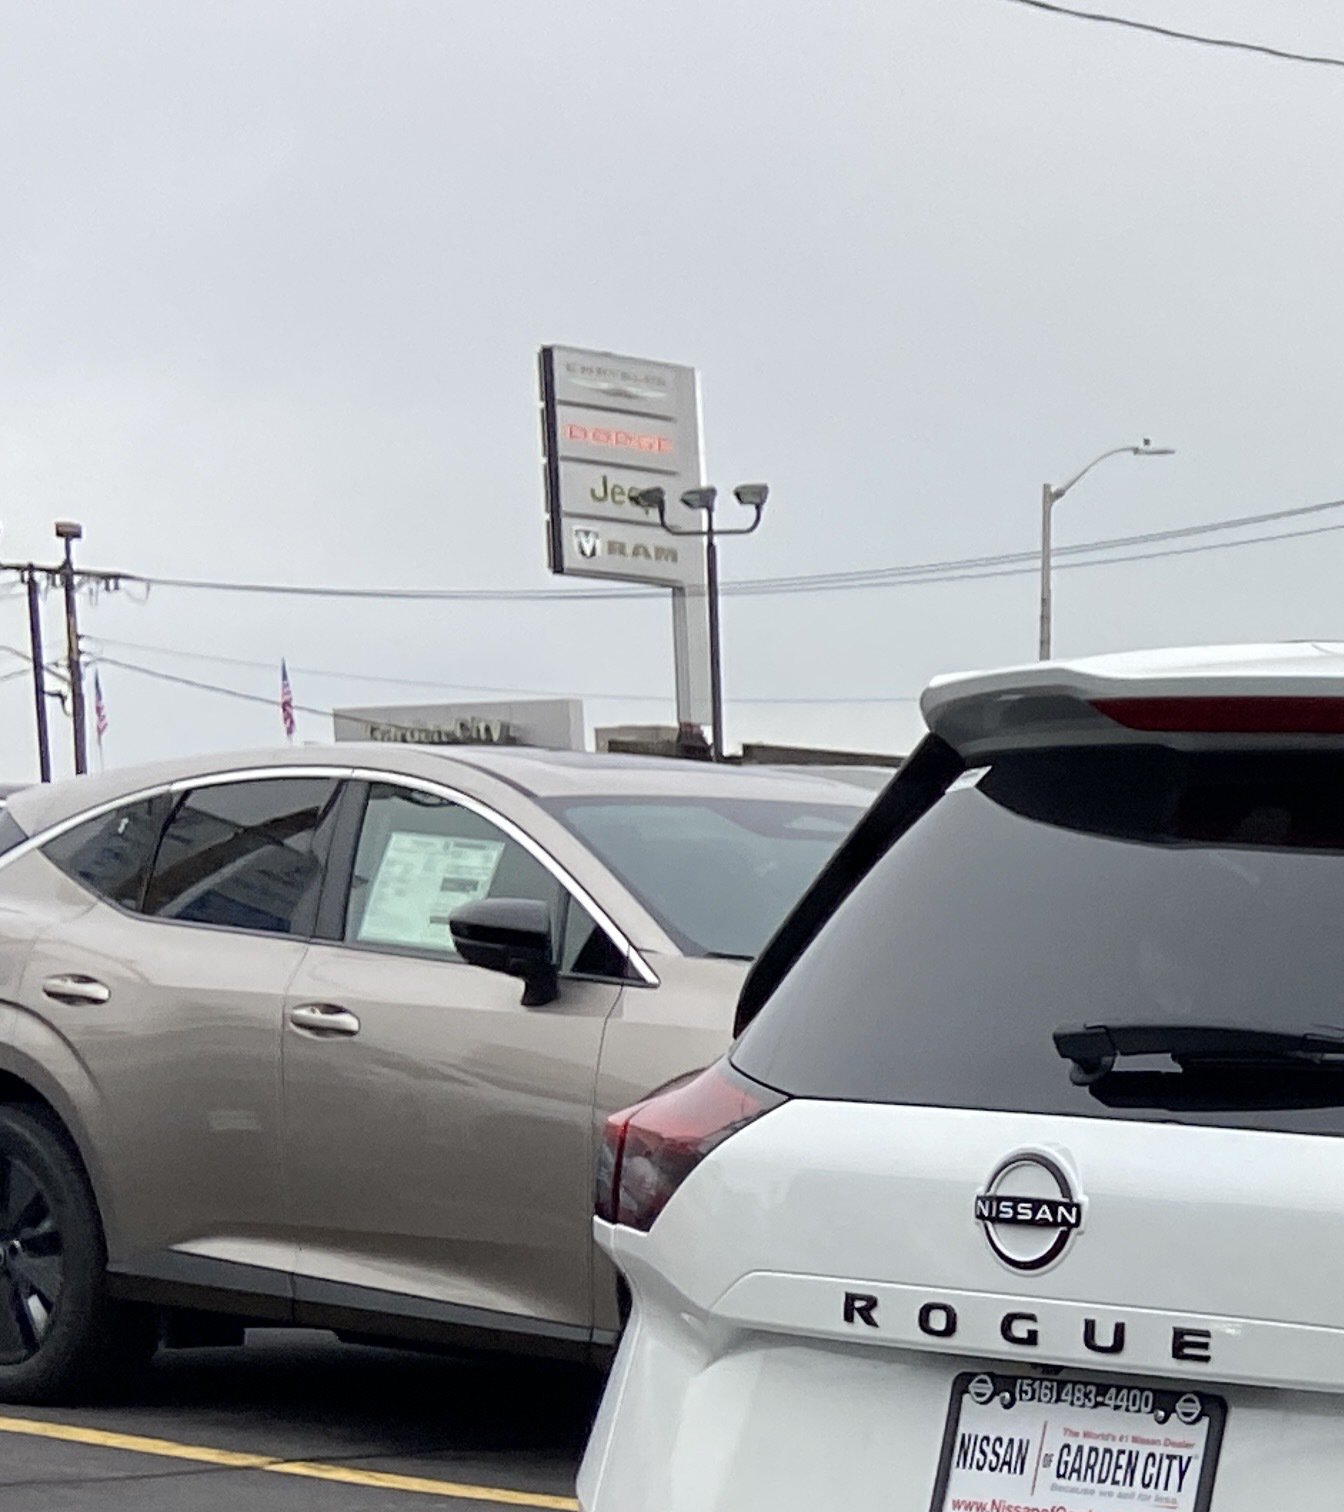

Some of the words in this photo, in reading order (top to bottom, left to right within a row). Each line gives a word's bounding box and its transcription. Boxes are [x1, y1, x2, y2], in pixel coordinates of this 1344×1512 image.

[567, 423, 673, 454] DODGE
[607, 539, 678, 564] RAM
[976, 1198, 1079, 1225] NISSAN
[842, 1291, 1213, 1363] ROGUE
[1014, 1378, 1058, 1403] (516)
[1060, 1383, 1154, 1414] 483-4400
[955, 1432, 1030, 1476] NISSAN
[1056, 1443, 1140, 1488] GARDEN
[1141, 1451, 1193, 1493] CITY
